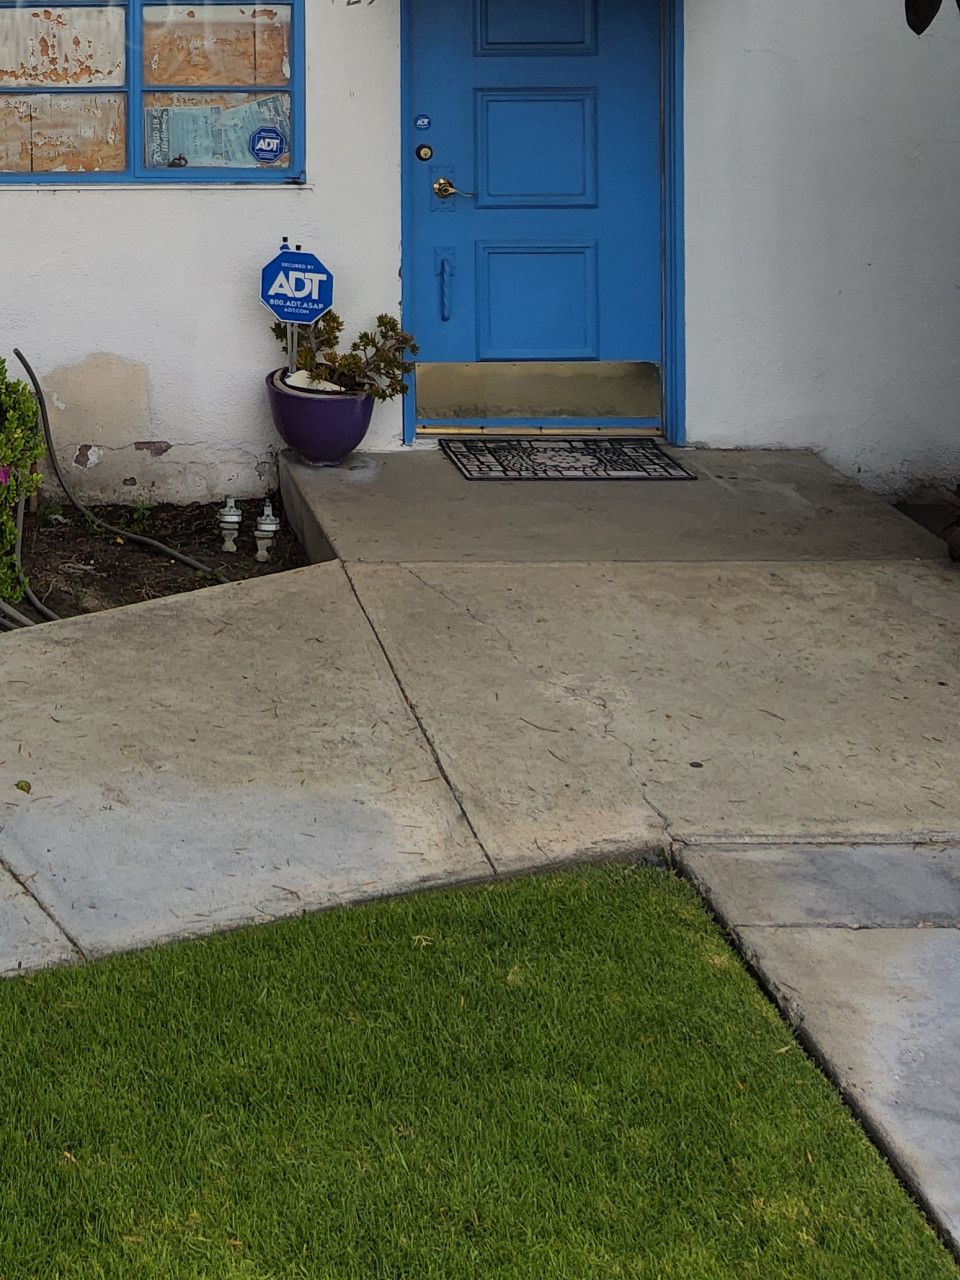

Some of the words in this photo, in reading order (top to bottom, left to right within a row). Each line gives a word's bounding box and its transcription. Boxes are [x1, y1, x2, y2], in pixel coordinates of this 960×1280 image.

[415, 118, 430, 126] ADT
[256, 138, 280, 151] ADT
[268, 271, 327, 300] ADT
